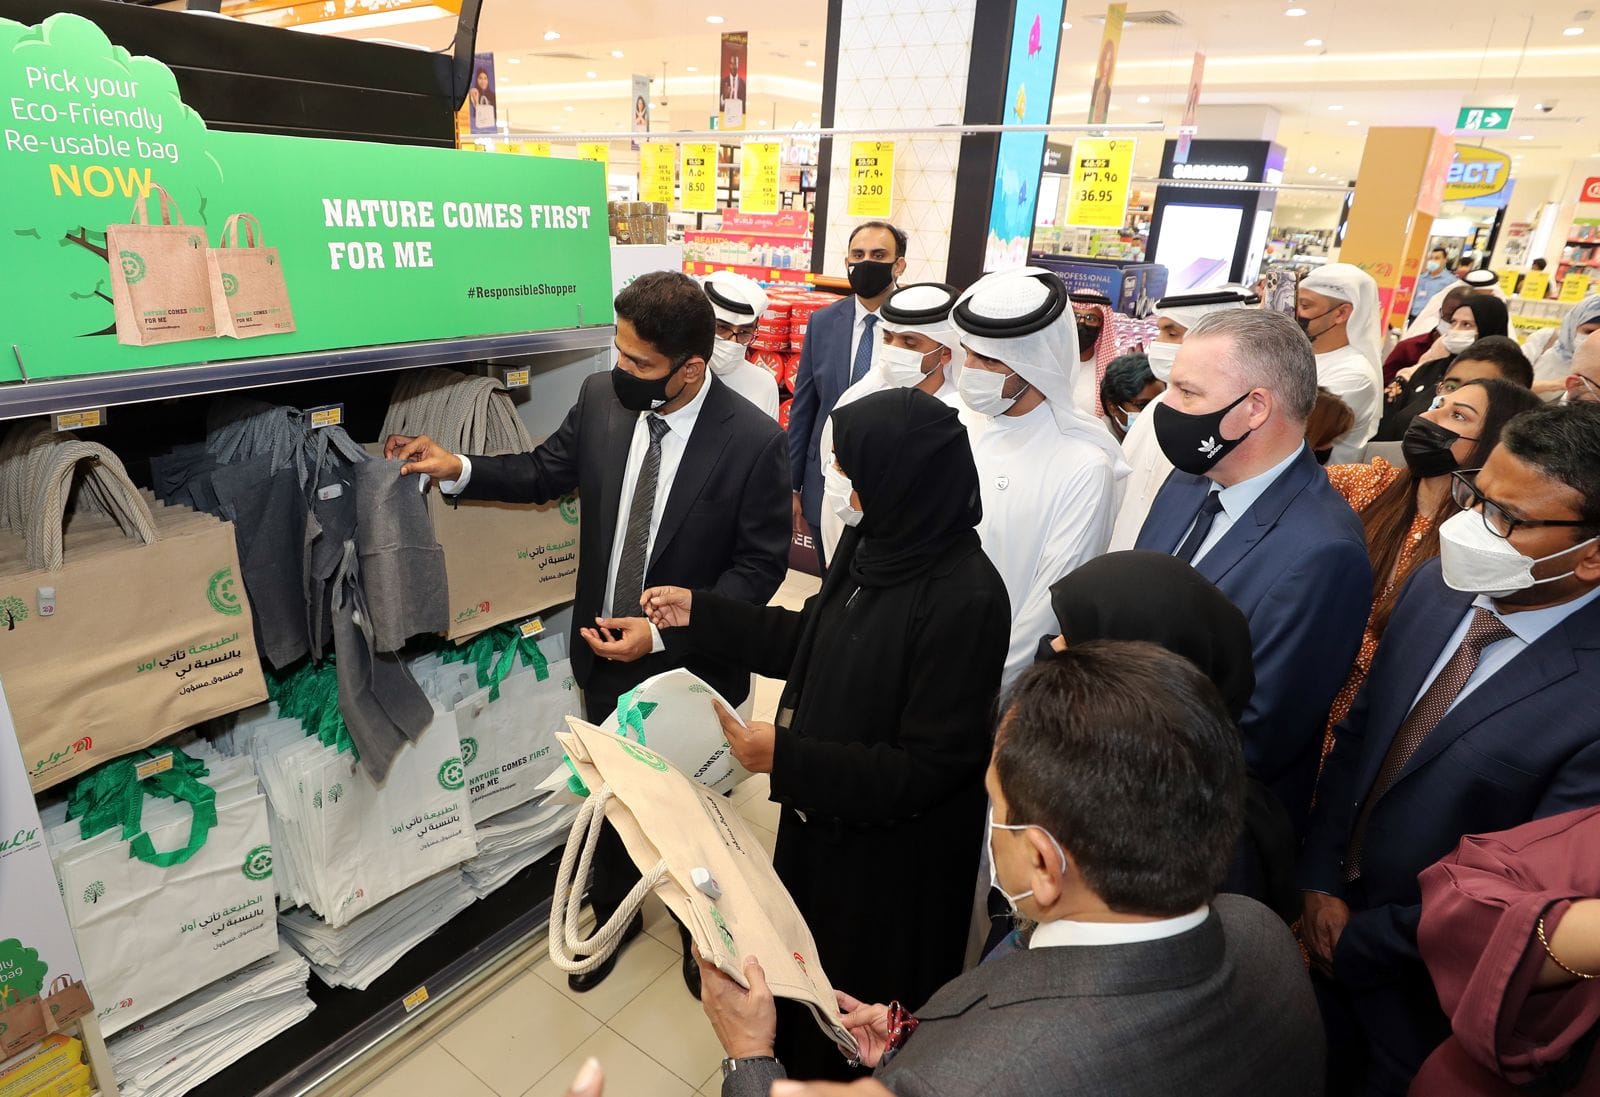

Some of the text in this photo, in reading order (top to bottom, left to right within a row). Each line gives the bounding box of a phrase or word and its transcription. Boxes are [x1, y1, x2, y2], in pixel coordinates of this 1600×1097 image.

[25, 66, 139, 99] Pick your
[10, 97, 162, 134] Eco-Friendly
[4, 129, 179, 164] Re-usable bag
[49, 163, 152, 198] NOW
[688, 182, 705, 192] 8.50
[857, 185, 883, 195] 32.90
[1081, 190, 1113, 202] 36.95
[321, 198, 591, 229] NATURE COMES FIRST
[327, 241, 434, 270] FOR ME
[467, 283, 577, 300] #ResponsibleShopper
[1207, 444, 1223, 458] adidas
[189, 632, 240, 656] الطبيعة
[159, 650, 186, 670] تأتي
[175, 650, 241, 680] بالنسبة لي
[469, 767, 500, 786] NATURE
[501, 756, 528, 772] COMES
[529, 746, 550, 761] FIRST
[694, 749, 725, 778] COMES
[470, 777, 500, 795] FOR ME
[428, 815, 460, 831] بالنسبة
[222, 895, 263, 917] الطبيعة
[211, 909, 264, 938] بالنسبة لي
